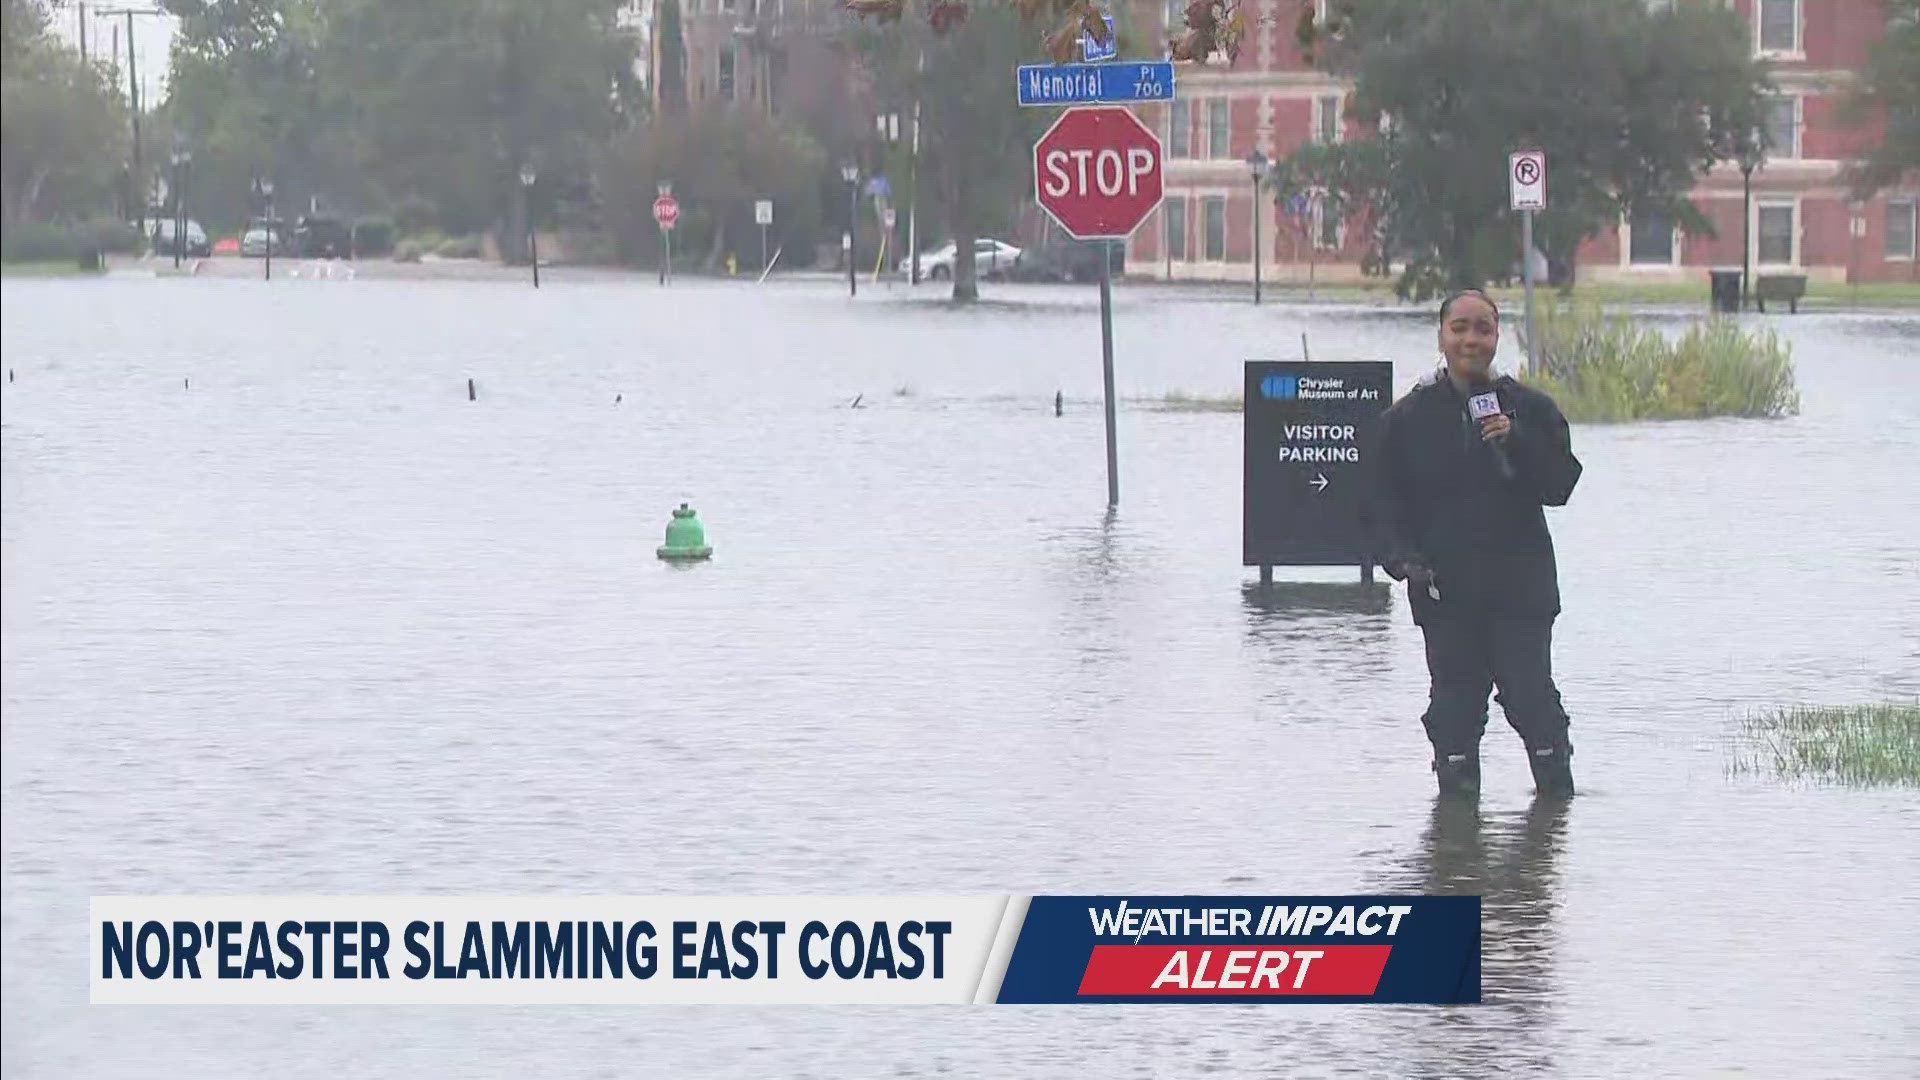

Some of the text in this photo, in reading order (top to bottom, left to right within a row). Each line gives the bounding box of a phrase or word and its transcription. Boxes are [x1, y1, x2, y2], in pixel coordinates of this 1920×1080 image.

[1030, 70, 1102, 99] Memorial
[1133, 83, 1162, 96] 700
[1045, 149, 1154, 197] STOP
[656, 205, 675, 216] STOP
[1298, 377, 1344, 390] Chrysler
[1298, 389, 1379, 399] Museum of Art
[1284, 425, 1355, 440] VISITOR
[1279, 447, 1359, 462] PARKING
